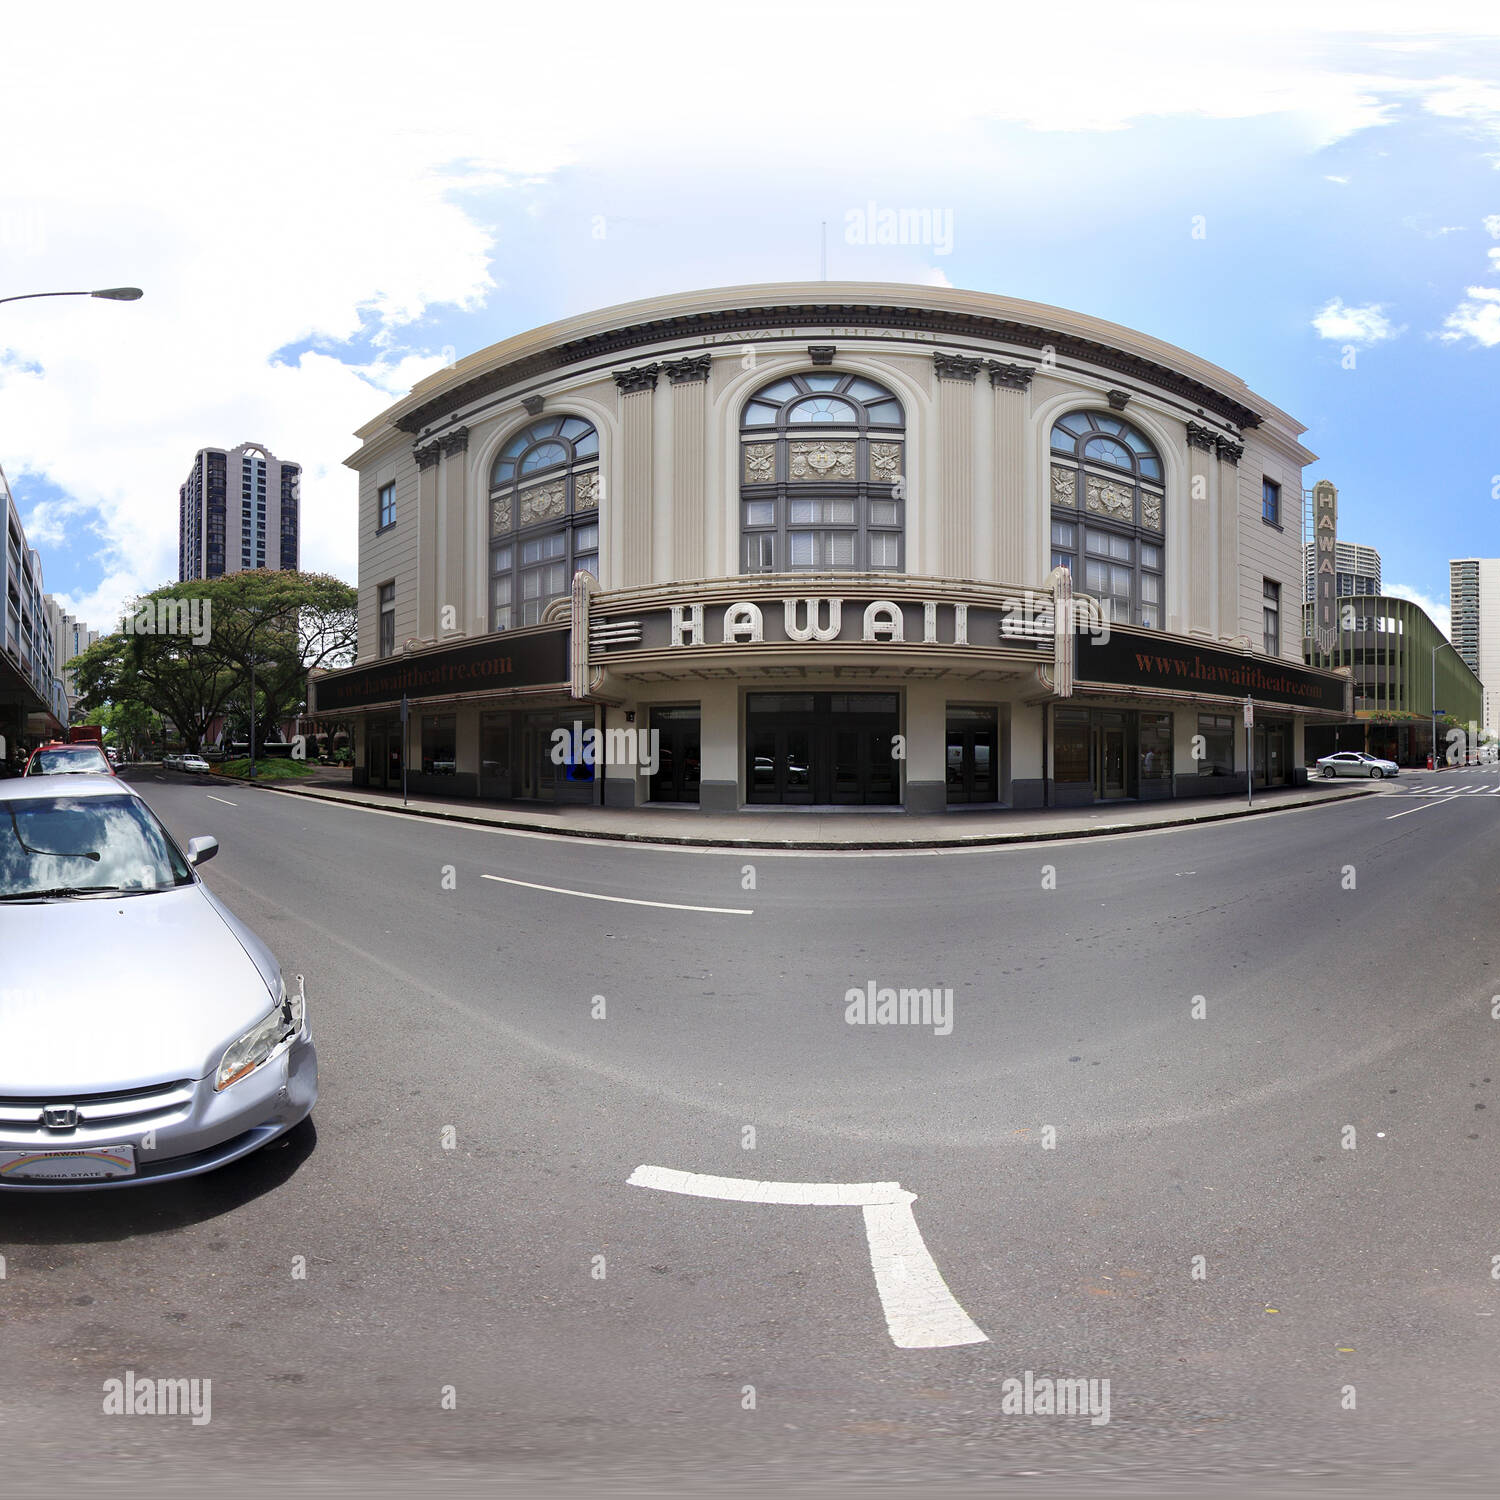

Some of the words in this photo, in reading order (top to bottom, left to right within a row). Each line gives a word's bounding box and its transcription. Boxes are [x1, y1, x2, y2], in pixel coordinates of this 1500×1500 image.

[703, 328, 796, 344] HAWAII
[828, 328, 946, 341] THEATRE
[1318, 493, 1334, 623] HAWAII
[669, 598, 969, 647] HAWAII
[1136, 654, 1322, 698] www.hawaiitheatre.com
